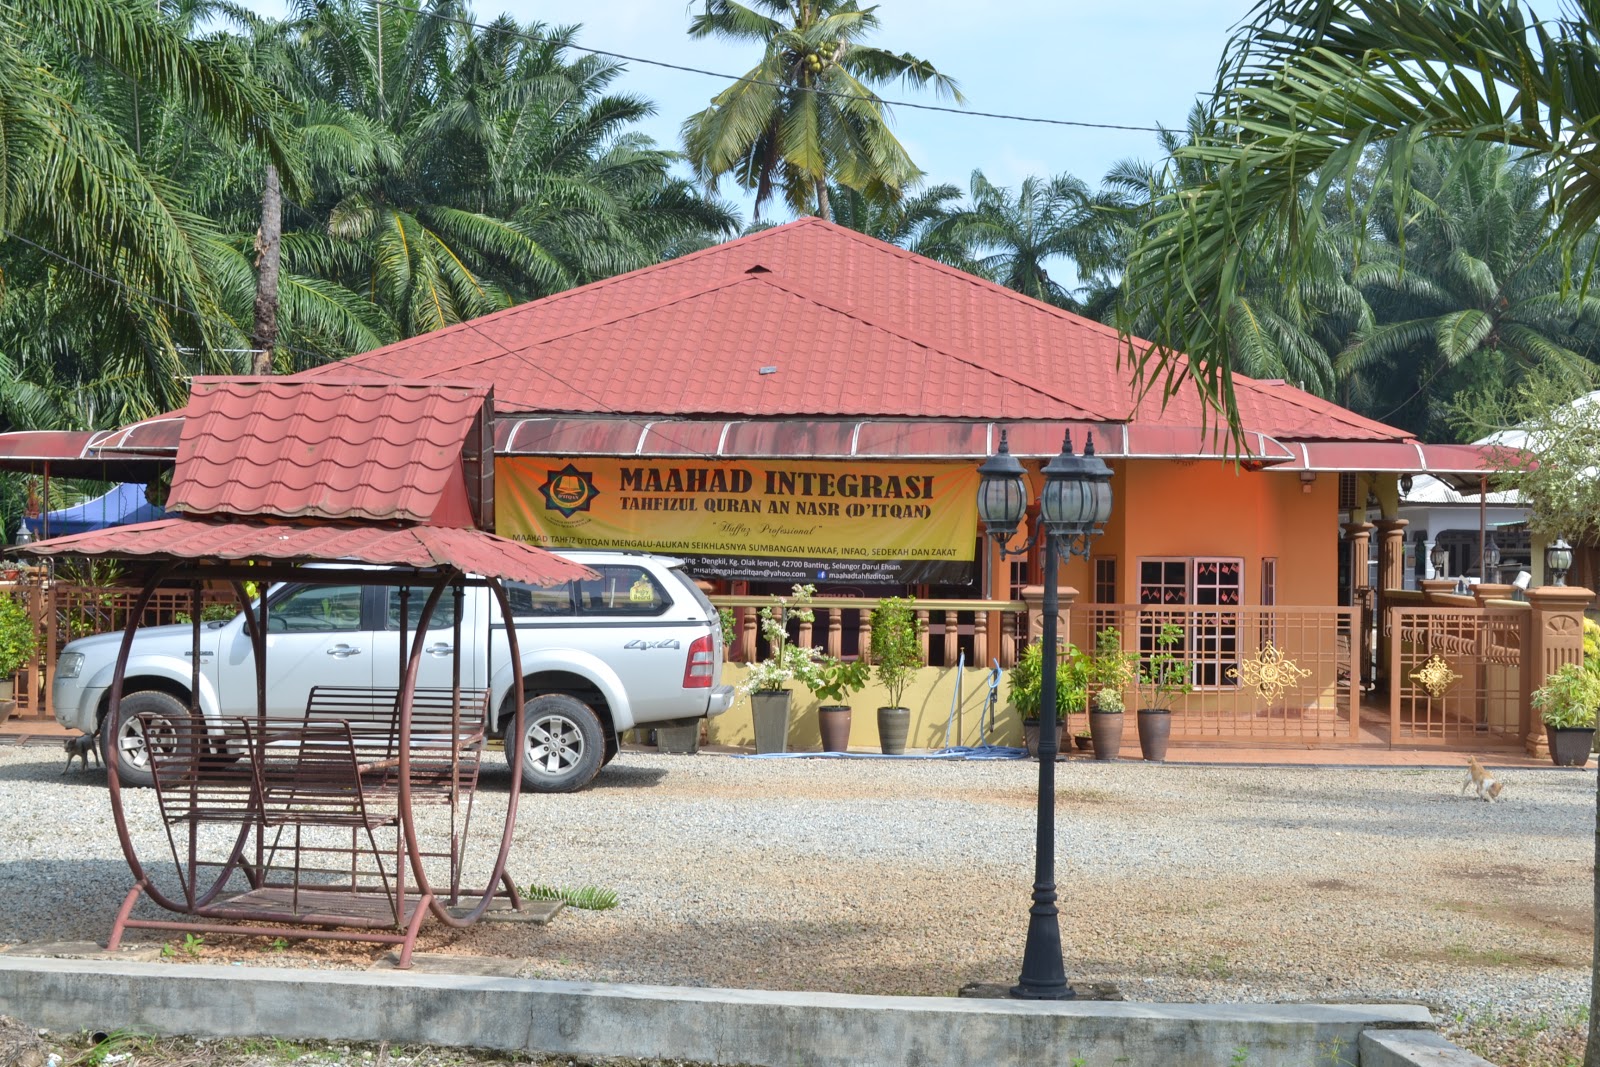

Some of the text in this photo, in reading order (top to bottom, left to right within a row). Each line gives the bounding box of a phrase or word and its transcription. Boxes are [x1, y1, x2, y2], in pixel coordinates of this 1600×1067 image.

[620, 467, 935, 499] MAAHAD INTEGRASI
[620, 497, 932, 519] TAHFIZUL QURAN AN NASR (D'ITQAN)
[512, 534, 548, 543] MAAHAD
[551, 536, 576, 544] TAHFIZ
[577, 537, 609, 546] D'ITQAN
[612, 539, 689, 549] MENGALU-ALUKAN
[692, 542, 747, 551] SEIKHLASNYA
[749, 544, 805, 553] SUMBANGAN
[807, 546, 839, 556] WAKAF,
[841, 548, 869, 557] INFAQ,
[872, 548, 909, 556] SEDEKAH
[931, 549, 957, 557] ZAKAT
[740, 559, 756, 567] Olak
[781, 560, 803, 568] 42700
[832, 562, 861, 572] Selangor
[861, 563, 880, 571] Darul
[693, 567, 807, 579] pusatpengajianditqan@yahoo.com
[828, 572, 894, 580] maahadtahfizditqan
[623, 639, 680, 650] 4x4
